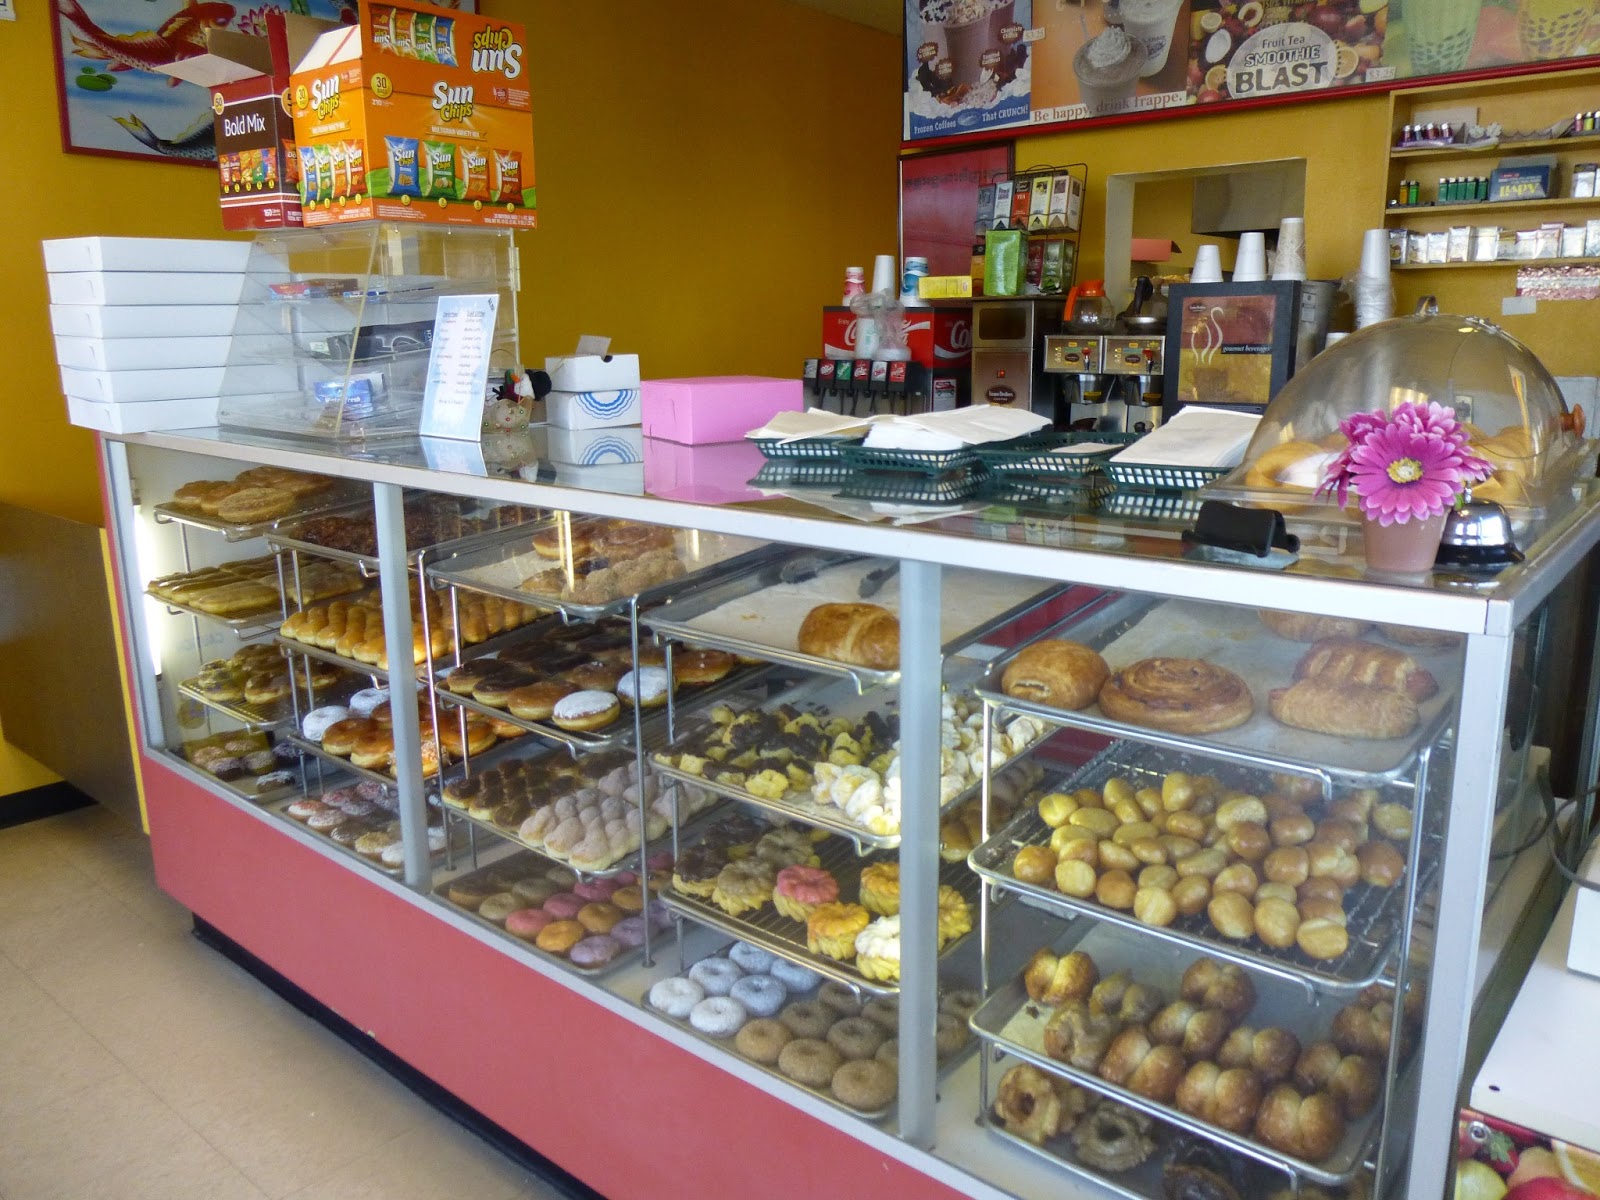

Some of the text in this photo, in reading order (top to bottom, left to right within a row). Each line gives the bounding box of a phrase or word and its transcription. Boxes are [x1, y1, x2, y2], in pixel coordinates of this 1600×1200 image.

[473, 25, 513, 51] Chips
[1262, 35, 1305, 49] Fruit Tea
[472, 43, 523, 79] Sun
[1244, 44, 1321, 68] SMOOTHIE
[376, 77, 387, 88] 30
[1235, 61, 1328, 94] BLAST
[311, 75, 340, 111] Sun
[432, 81, 474, 109] Sun
[318, 93, 340, 120] Chips
[440, 102, 473, 122] Chips
[1033, 110, 1049, 122] Be
[1096, 98, 1130, 113] drink
[224, 113, 266, 137] Bold Mix
[914, 124, 934, 134] Frozen
[935, 119, 956, 130] Coffees
[982, 111, 997, 122] That
[998, 104, 1029, 119] CRUNCH!
[395, 148, 414, 161] Sun
[433, 152, 451, 165] Sun
[469, 156, 487, 169] Sun
[502, 159, 518, 172] Sun
[1222, 344, 1272, 353] gourmet beverages
